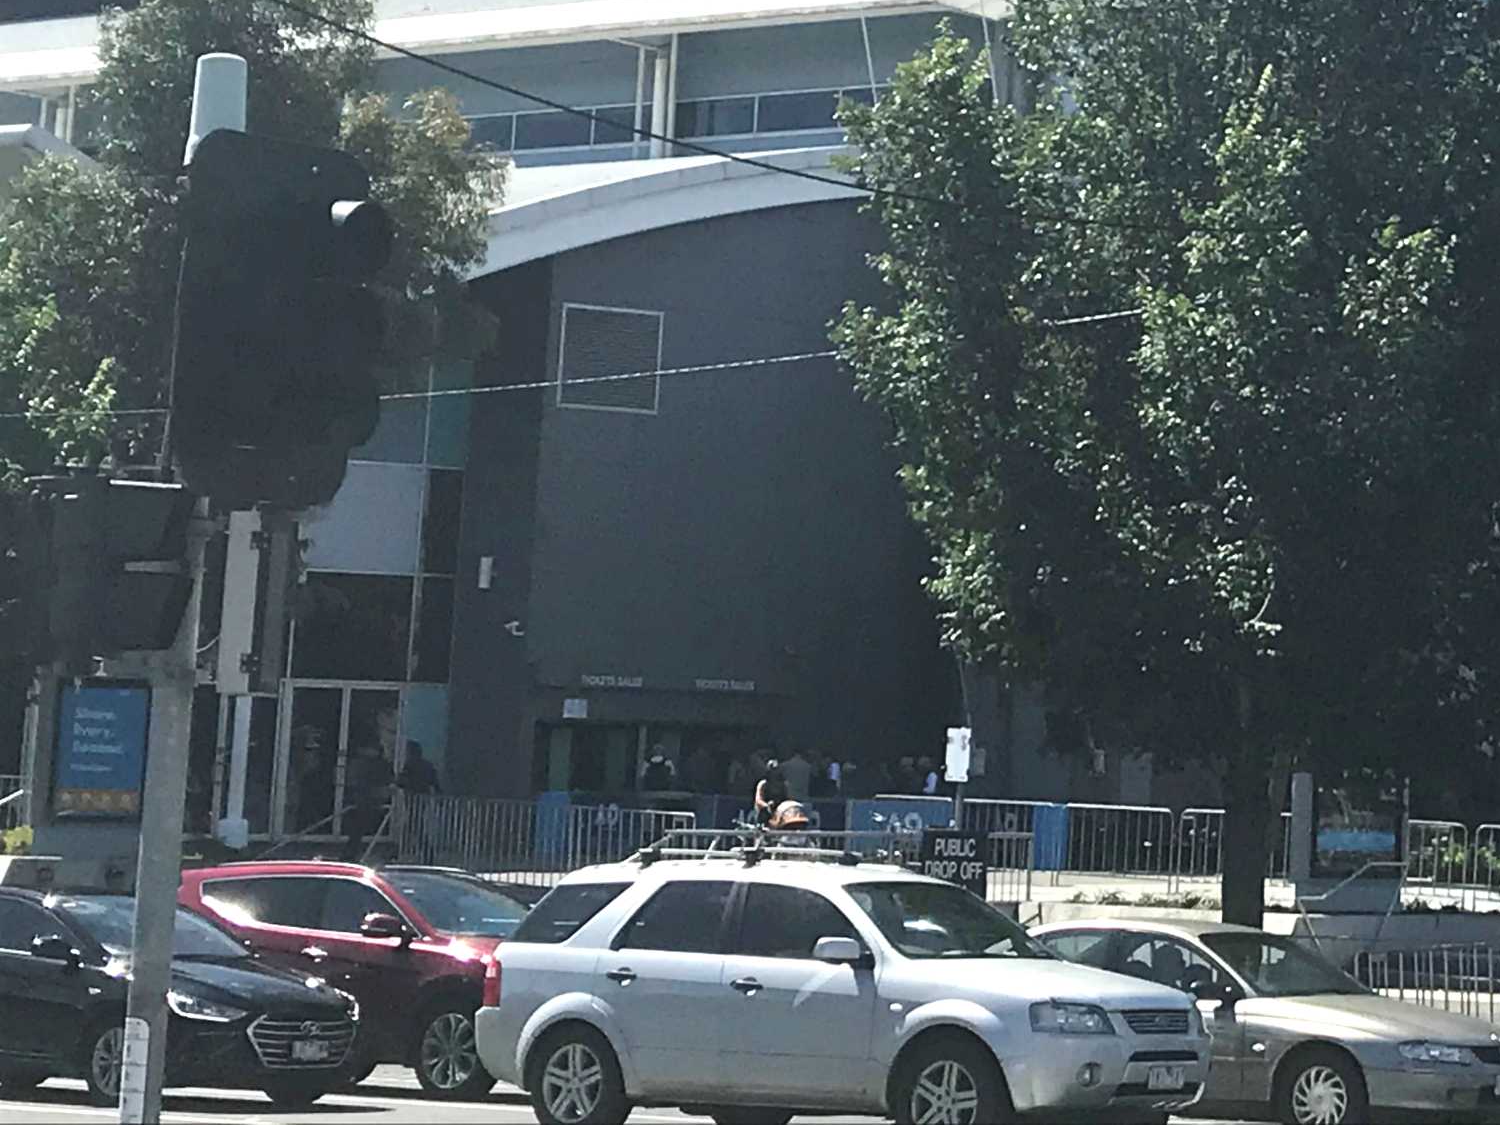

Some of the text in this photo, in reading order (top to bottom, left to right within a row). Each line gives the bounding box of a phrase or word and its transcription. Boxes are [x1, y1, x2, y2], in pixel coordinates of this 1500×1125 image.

[934, 838, 976, 857] PUBLIC
[924, 860, 983, 880] DROP OFF
